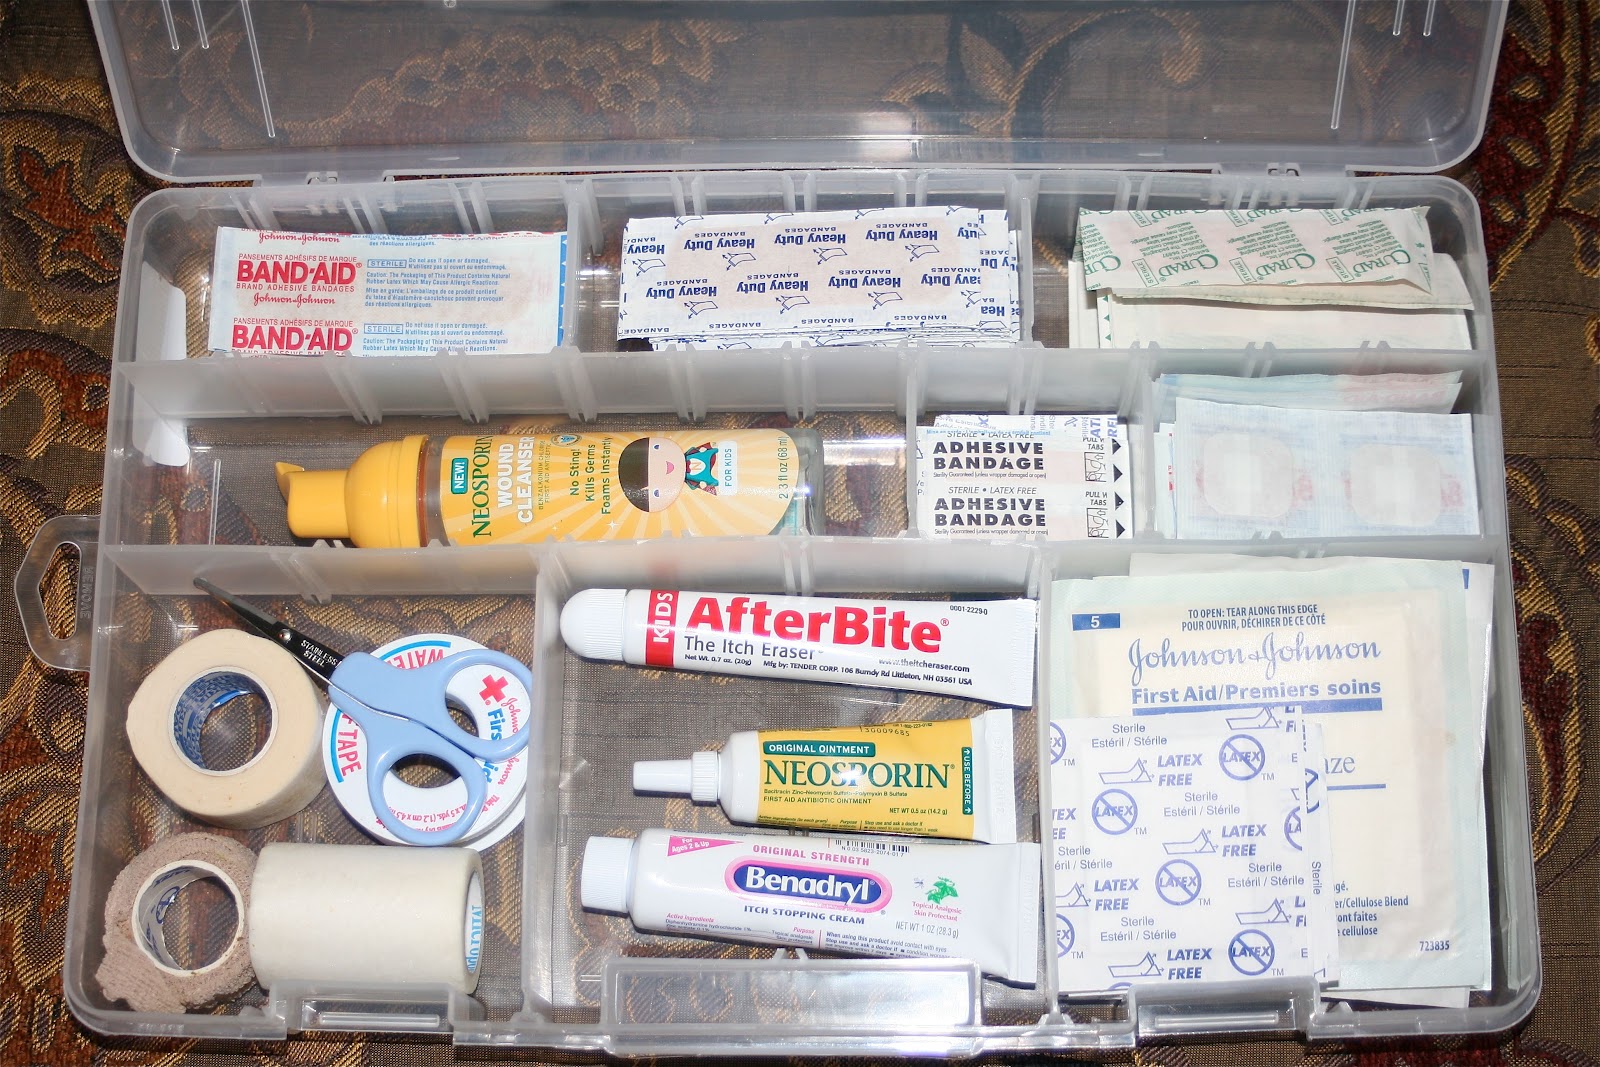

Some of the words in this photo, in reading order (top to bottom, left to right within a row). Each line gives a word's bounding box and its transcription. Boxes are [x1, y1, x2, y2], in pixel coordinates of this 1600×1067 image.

[866, 230, 895, 242] Duty
[899, 230, 938, 241] Heavy
[684, 239, 712, 251] Duty
[717, 238, 755, 249] Heavy
[285, 254, 317, 262] ADHÉSIFS
[267, 284, 308, 292] ADHESIVE
[736, 282, 766, 293] Duty
[770, 280, 809, 291] Heavy
[828, 277, 858, 289] Duty
[862, 276, 901, 288] Heavy
[933, 441, 1044, 455] ADHESIVE
[585, 444, 596, 474] Germs
[601, 436, 613, 474] Instantly
[724, 448, 733, 468] KIDS
[570, 448, 581, 478] Sting!
[934, 457, 1044, 471] BANDAGE
[454, 461, 465, 489] NEW!
[497, 443, 515, 508] WOUND
[516, 436, 535, 524] CLEANSER
[724, 470, 733, 487] FOR
[570, 481, 580, 496] No
[585, 476, 595, 502] Kills
[948, 487, 979, 495] STERILE
[990, 487, 1014, 495] LATEX
[1016, 487, 1038, 495] FREE
[601, 477, 611, 515] Foams
[934, 498, 1045, 511] ADHESIVE
[935, 514, 1046, 527] BANDAGE
[1188, 609, 1199, 618] TO
[1200, 608, 1225, 618] OPEN:
[1226, 607, 1246, 617] TEAR
[1248, 606, 1276, 616] ALONG
[1277, 605, 1296, 615] THIS
[1297, 604, 1318, 614] EDGE
[653, 592, 673, 644] KIDS
[1091, 616, 1100, 628] 5
[1182, 621, 1204, 632] POUR
[1206, 619, 1240, 631] OUVRIR,
[1242, 618, 1281, 629] DÉCHIRER
[1282, 617, 1293, 627] DE
[1295, 616, 1304, 626] CE
[1306, 613, 1326, 626] CÔTÉ
[684, 636, 715, 652] The
[723, 638, 754, 655] Itch
[303, 650, 325, 668] STEEL
[734, 657, 752, 666] (20g)
[764, 660, 777, 668] Mfg
[778, 661, 788, 669] by:
[790, 662, 817, 670] TENDER
[936, 676, 956, 684] 03561
[958, 678, 972, 686] USA
[1132, 688, 1179, 705] First
[1183, 682, 1320, 702] Aid/Premiers
[1328, 679, 1381, 695] soins
[1112, 724, 1146, 734] Sterile
[1092, 738, 1124, 748] Estéril
[1134, 736, 1168, 746] Stérile
[338, 728, 362, 777] TAPE
[769, 744, 816, 753] ORIGINAL
[818, 745, 870, 754] OINTMENT
[1158, 753, 1203, 768] LATEX
[1158, 773, 1193, 786] FREE
[1184, 792, 1218, 801] Sterile
[1222, 824, 1267, 838] LATEX
[672, 844, 688, 853] Ages
[753, 844, 806, 858] ORIGINAL
[811, 852, 870, 866] STRENGTH
[1222, 844, 1256, 857] FREE
[1080, 859, 1113, 870] Stérile
[1094, 878, 1140, 892] LATEX
[1312, 862, 1322, 895] Sterile
[1095, 898, 1130, 911] FREE
[1385, 896, 1409, 907] Blend
[744, 905, 769, 914] ITCH
[773, 908, 826, 920] STOPPING
[829, 915, 865, 925] CREAM
[928, 912, 958, 922] Protectant
[1354, 911, 1377, 922] faites
[896, 921, 907, 930] NET
[909, 923, 920, 931] WT
[927, 925, 936, 934] OZ
[937, 926, 952, 936] (28.3
[953, 928, 959, 939] g)
[1342, 926, 1378, 936] cellulose
[1419, 941, 1450, 952] 723835
[1167, 948, 1213, 961] LATEX
[1168, 967, 1202, 980] FREE
